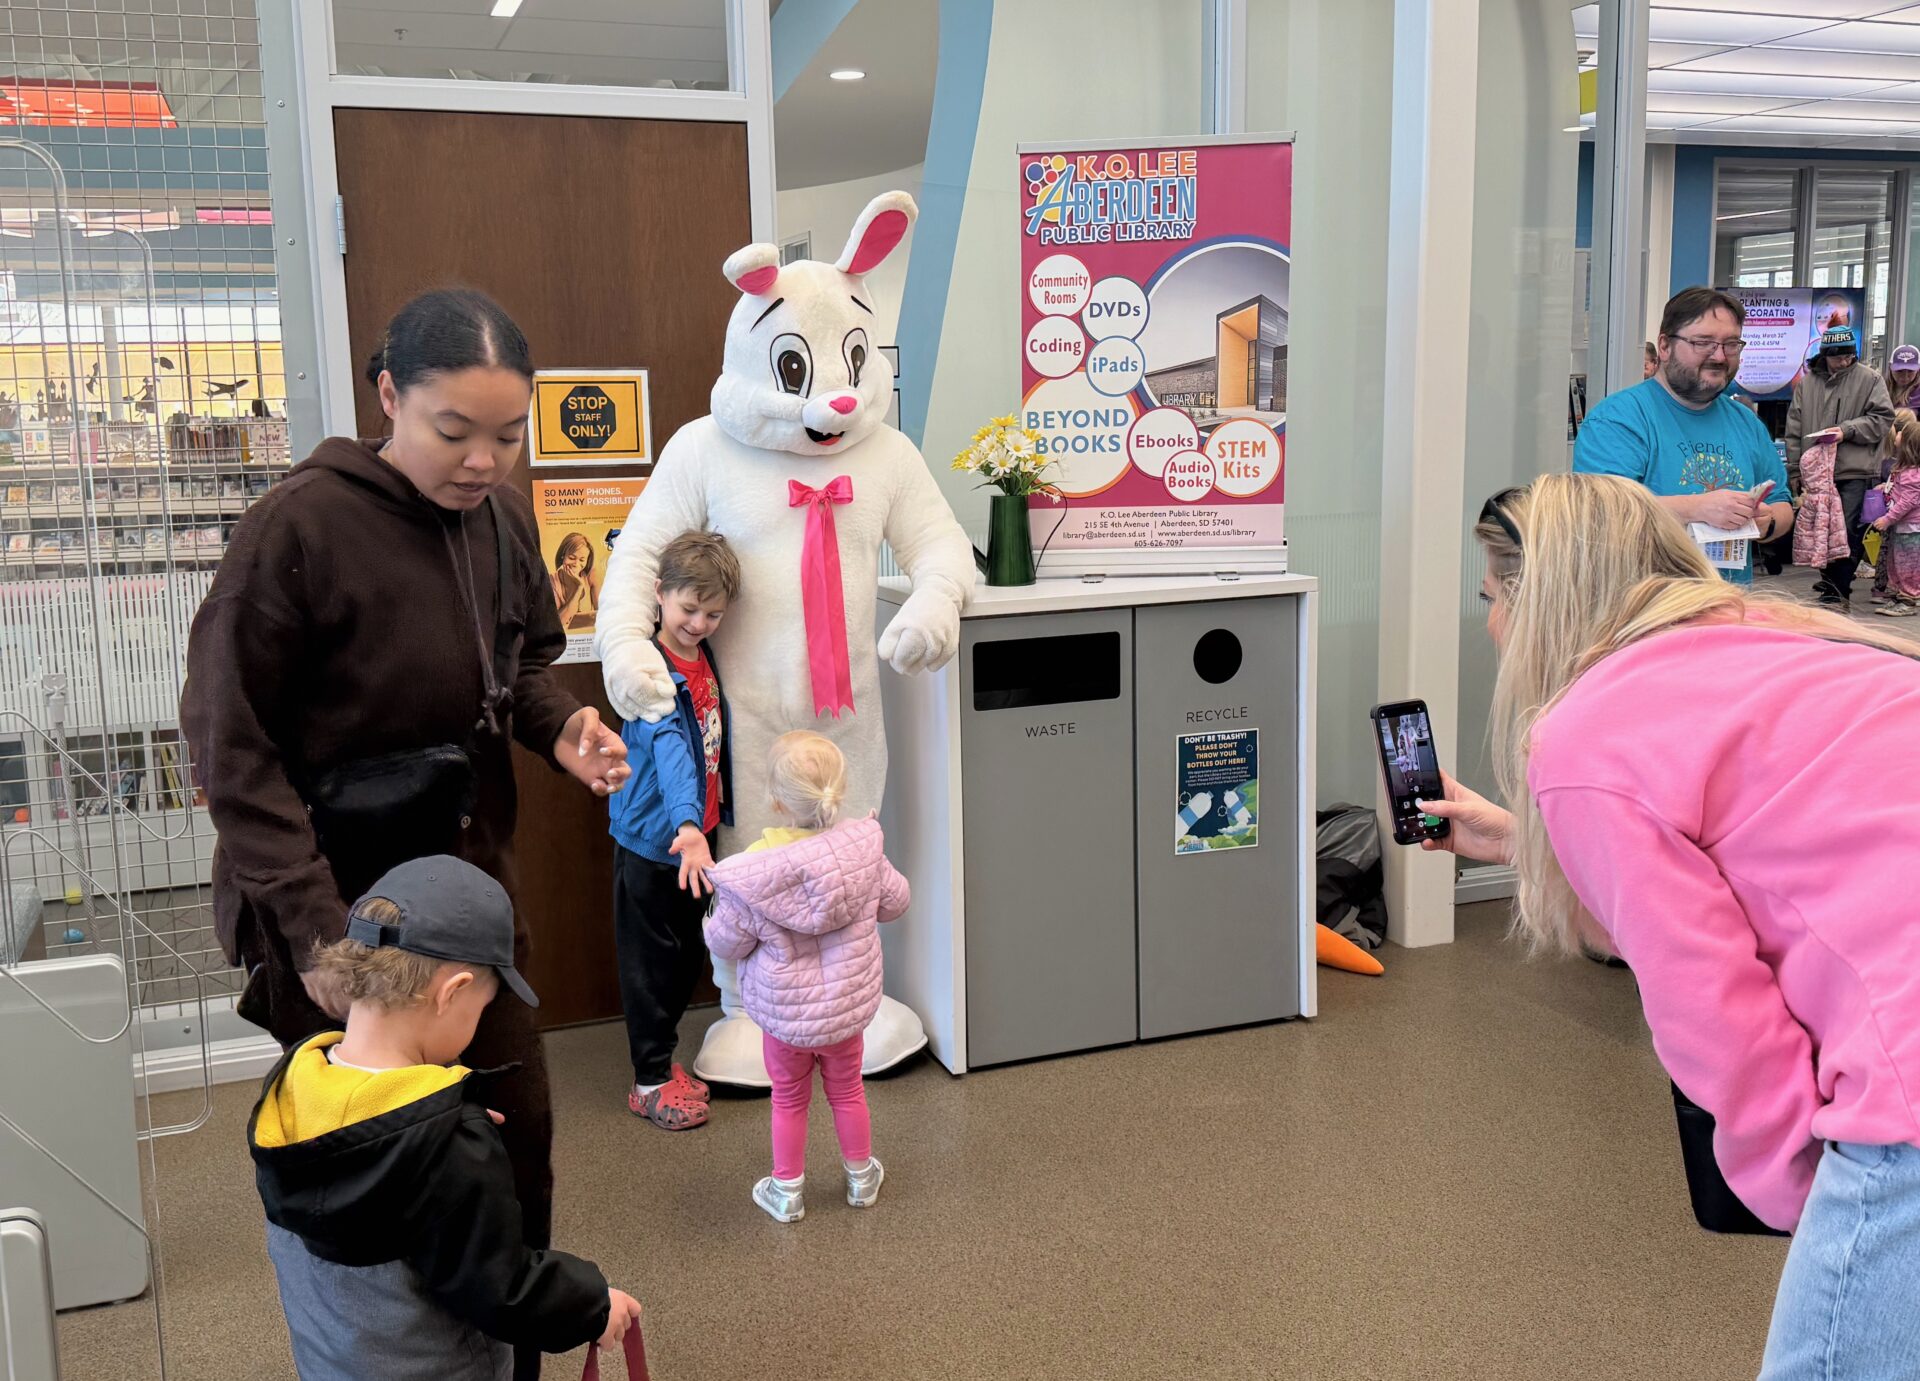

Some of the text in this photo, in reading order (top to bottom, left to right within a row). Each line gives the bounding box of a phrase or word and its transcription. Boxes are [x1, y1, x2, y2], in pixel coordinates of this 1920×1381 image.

[1077, 151, 1197, 180] K.O. LEE
[1026, 164, 1196, 234] ABERDEEN
[1041, 222, 1196, 244] PUBLIC LIBRARY
[1032, 273, 1088, 290] Community
[1044, 291, 1076, 304] Rooms
[1090, 302, 1140, 318] DVDs
[1823, 333, 1850, 343] NTHERS
[1030, 338, 1081, 356] Coding
[1093, 356, 1138, 373] iPads
[568, 397, 607, 410] STOP
[575, 413, 601, 421] STAFF
[1027, 408, 1129, 429] BEYOND
[569, 425, 610, 437] ONLY!
[1035, 434, 1121, 454] BOOKS
[1136, 434, 1193, 448] Ebooks
[1218, 440, 1266, 458] STEM
[1169, 462, 1210, 473] Audio
[1223, 462, 1260, 478] Kits
[1169, 476, 1211, 488] Books
[587, 497, 638, 505] POSSIBILITI
[1186, 707, 1248, 723] RECYCLE
[1025, 723, 1076, 738] WASTE
